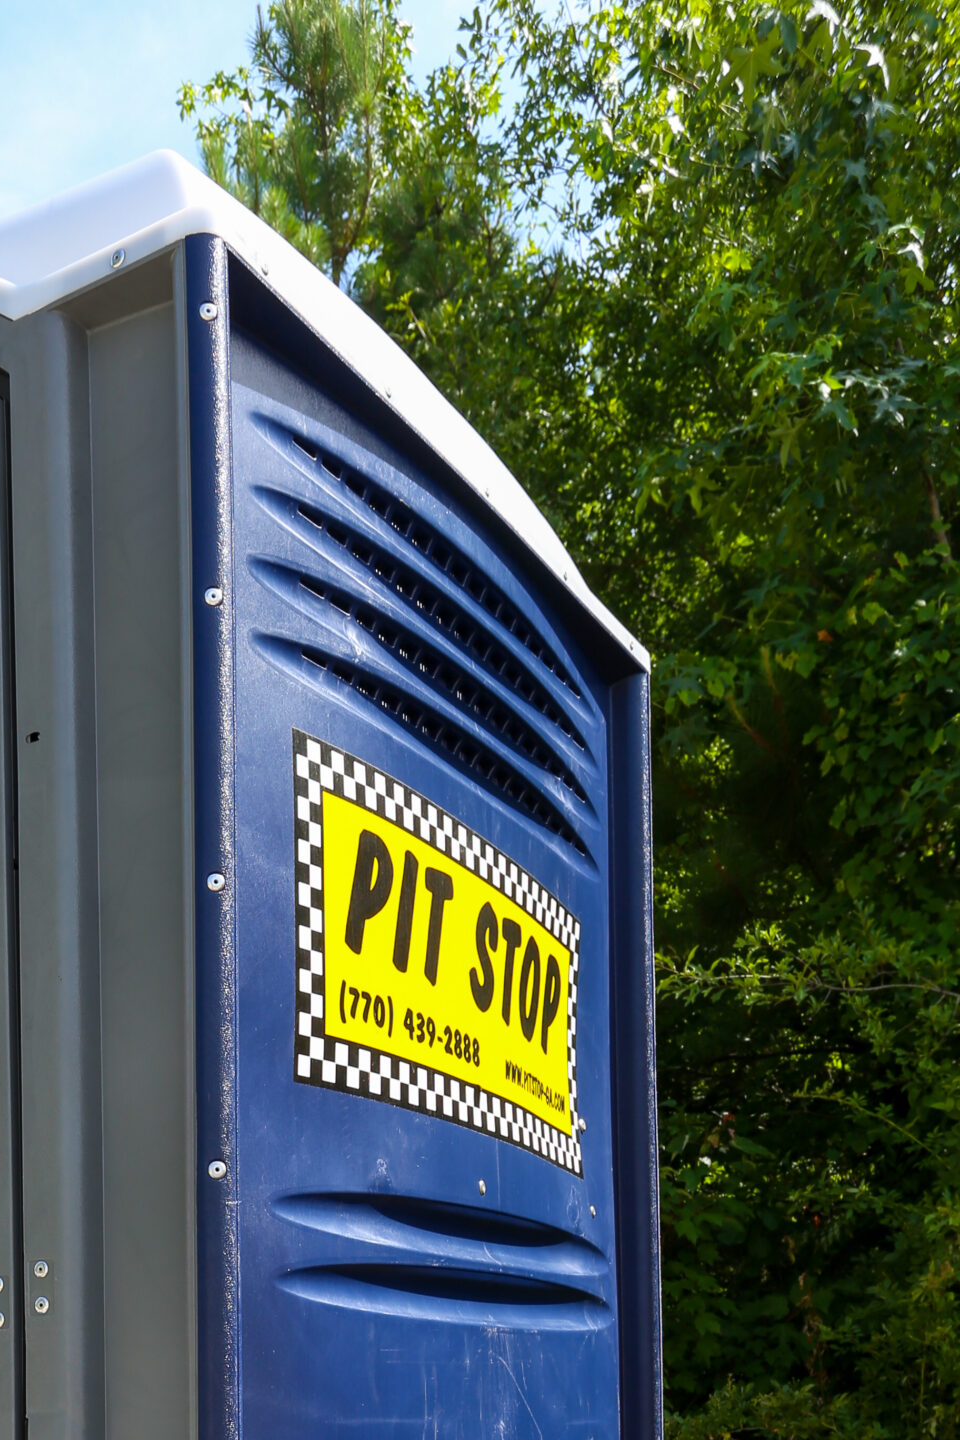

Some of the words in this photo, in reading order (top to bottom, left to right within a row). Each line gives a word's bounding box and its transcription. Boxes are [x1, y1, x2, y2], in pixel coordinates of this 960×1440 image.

[344, 828, 454, 987] PIT
[469, 901, 561, 1055] STOP
[338, 980, 394, 1037] (770)
[402, 1007, 481, 1067] 439-2888
[504, 1059, 566, 1115] WWW.PITSTOP-GA.COM
